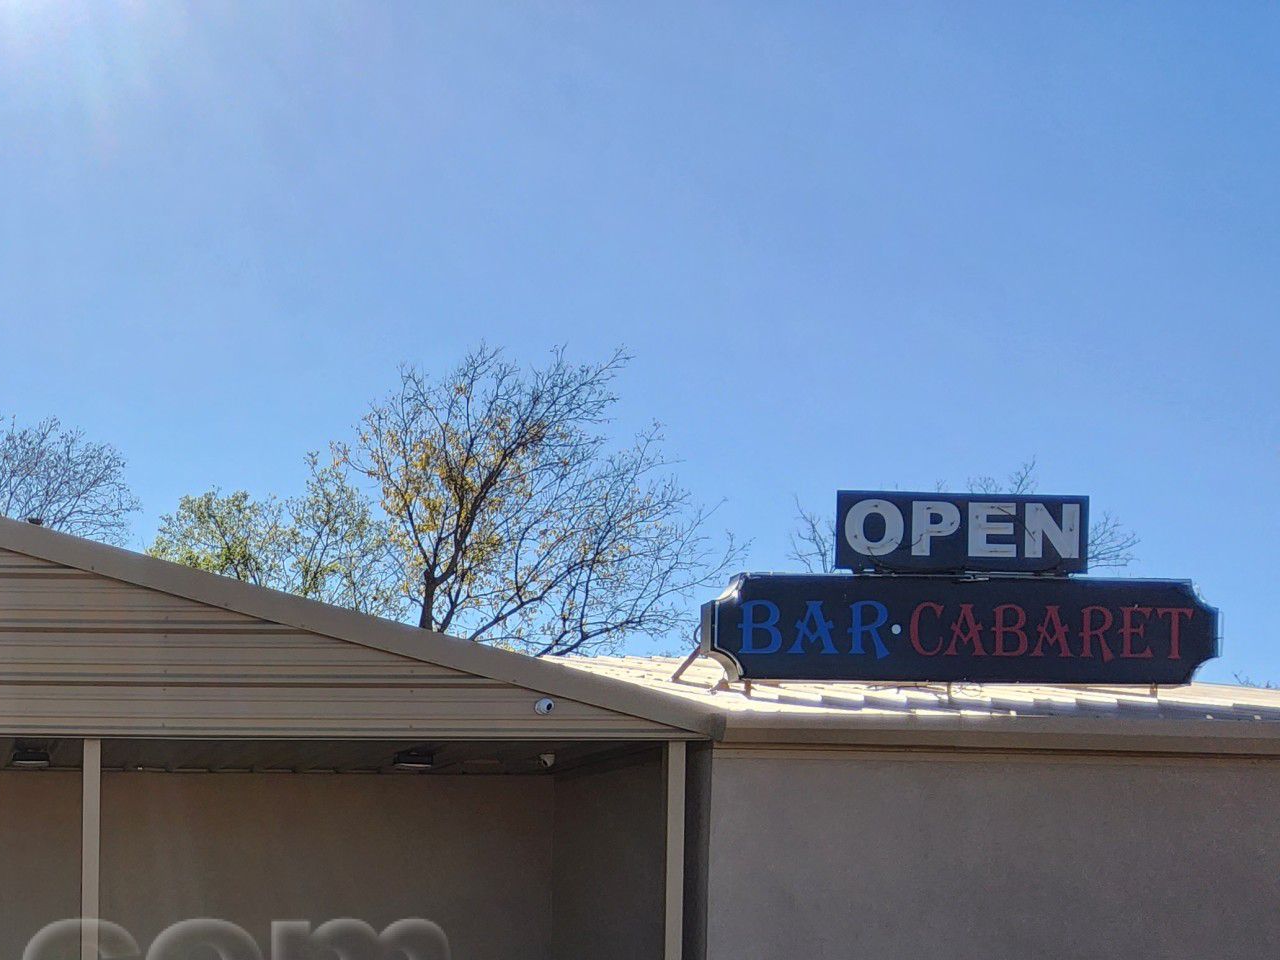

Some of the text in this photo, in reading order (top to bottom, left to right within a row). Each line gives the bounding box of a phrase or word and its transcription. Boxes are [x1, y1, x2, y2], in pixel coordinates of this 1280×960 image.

[844, 498, 1080, 559] OPEN
[737, 598, 1195, 663] BAR CABARET
